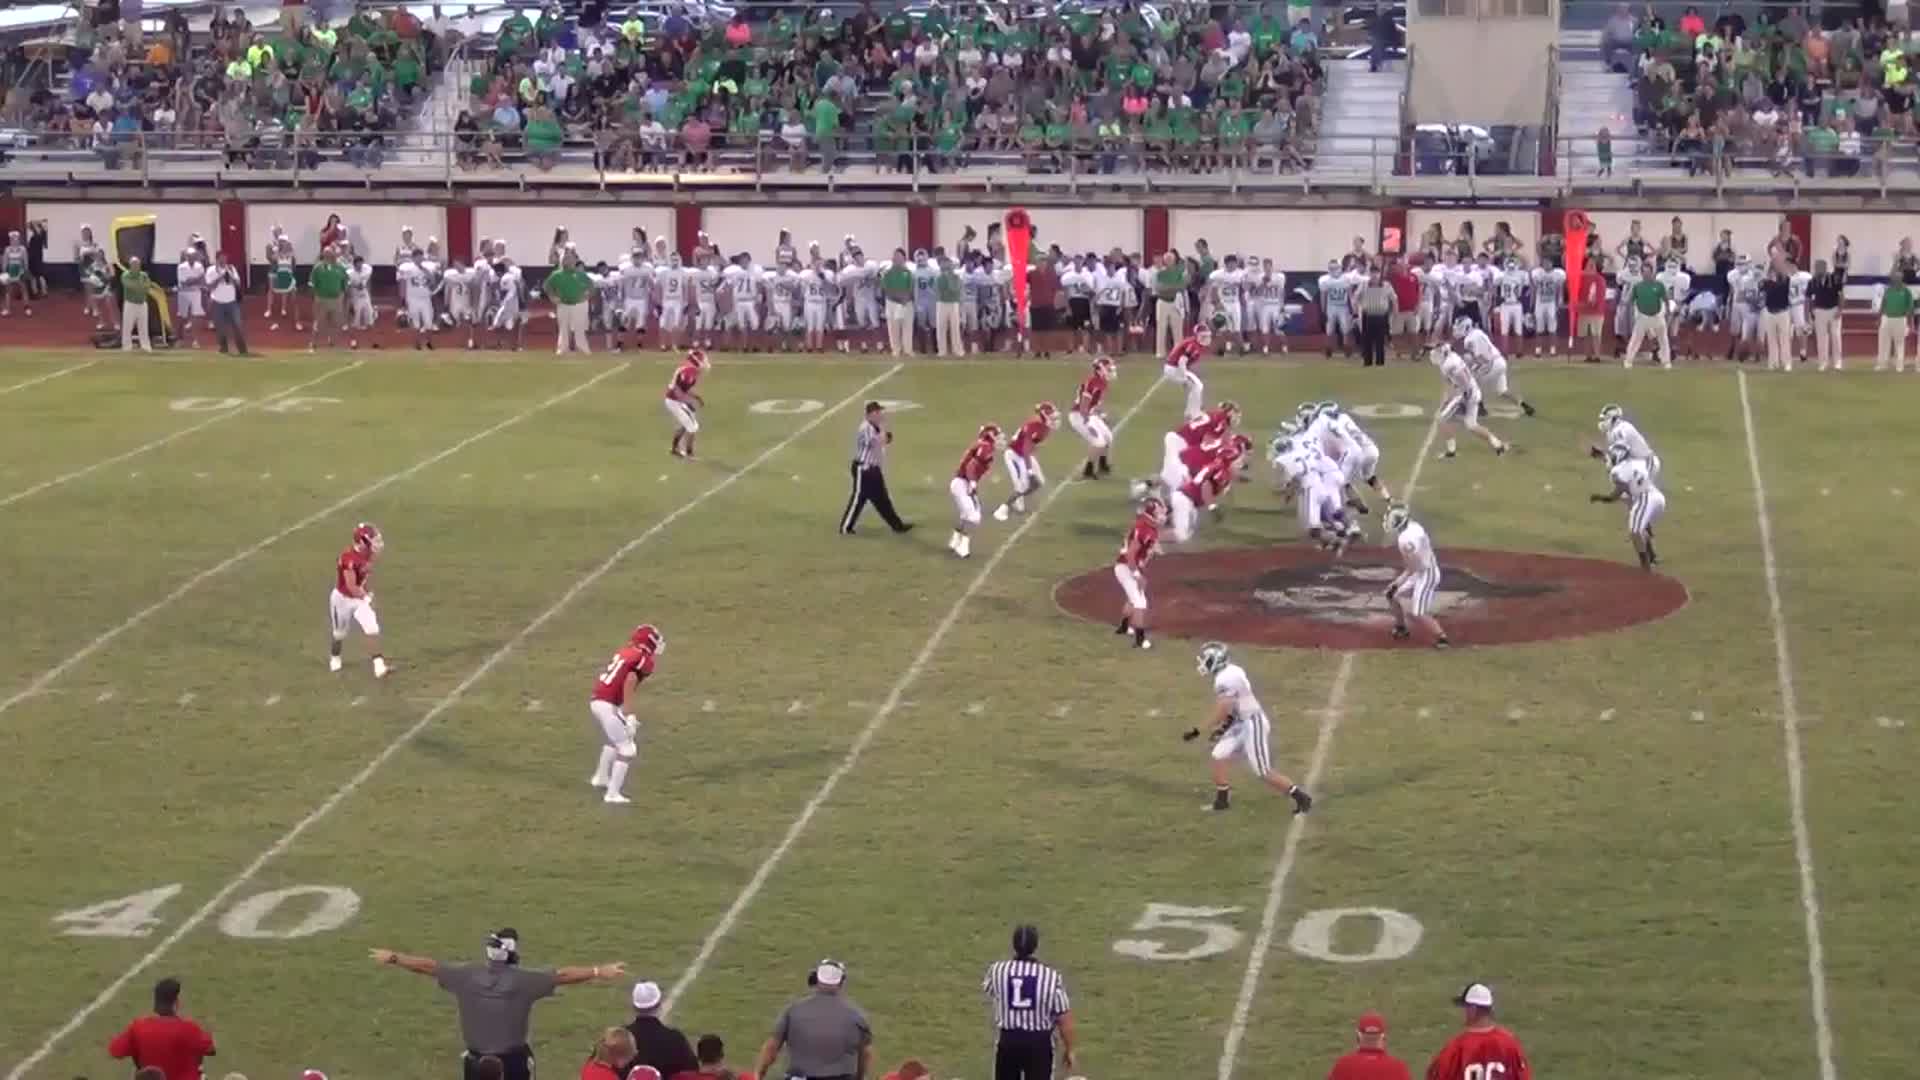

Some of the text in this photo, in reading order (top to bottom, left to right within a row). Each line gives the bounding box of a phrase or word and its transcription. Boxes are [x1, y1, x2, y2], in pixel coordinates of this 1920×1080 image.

[669, 279, 679, 293] 9
[52, 883, 361, 938] 40
[1113, 903, 1424, 962] 50
[1012, 978, 1032, 1007] L
